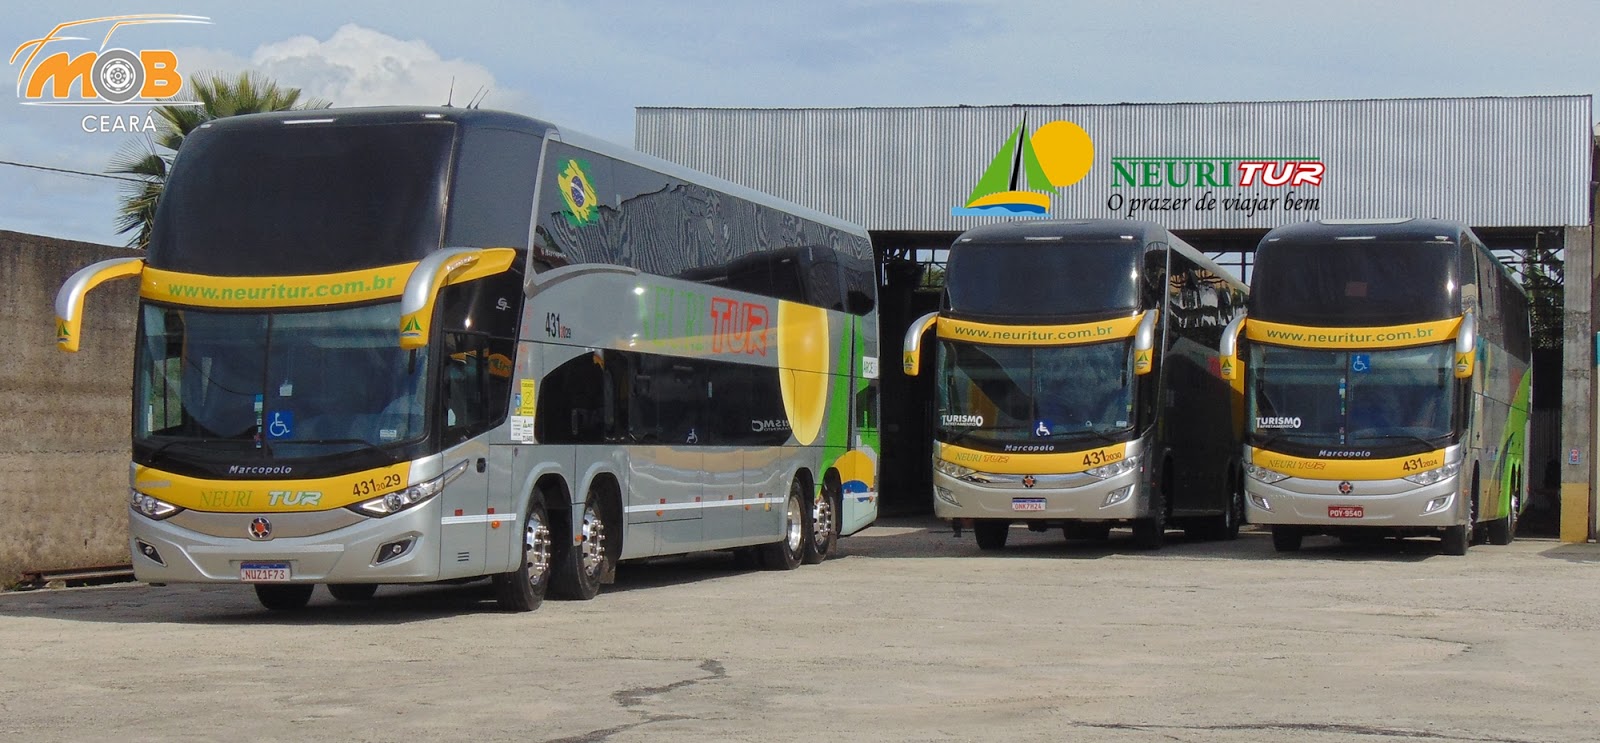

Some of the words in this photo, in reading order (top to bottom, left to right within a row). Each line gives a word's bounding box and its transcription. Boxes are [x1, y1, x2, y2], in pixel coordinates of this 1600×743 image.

[168, 274, 396, 301] www.neuritur.com.br
[711, 296, 769, 357] TUR
[954, 324, 1113, 341] www.neuritur.com.br
[1266, 326, 1434, 342] www.neuritur.com.br
[942, 415, 984, 427] TURISMO
[1255, 417, 1301, 429] TURISMO
[1004, 444, 1055, 452] Marcopolo
[1318, 450, 1371, 458] Marcopolo
[955, 452, 981, 463] NEURI
[229, 465, 292, 475] Marcopolo
[1267, 459, 1297, 469] NEURI
[1298, 461, 1326, 470] TUR
[200, 490, 253, 507] NEURI
[268, 490, 323, 507] TUR
[245, 569, 285, 580] NUZ1F73
